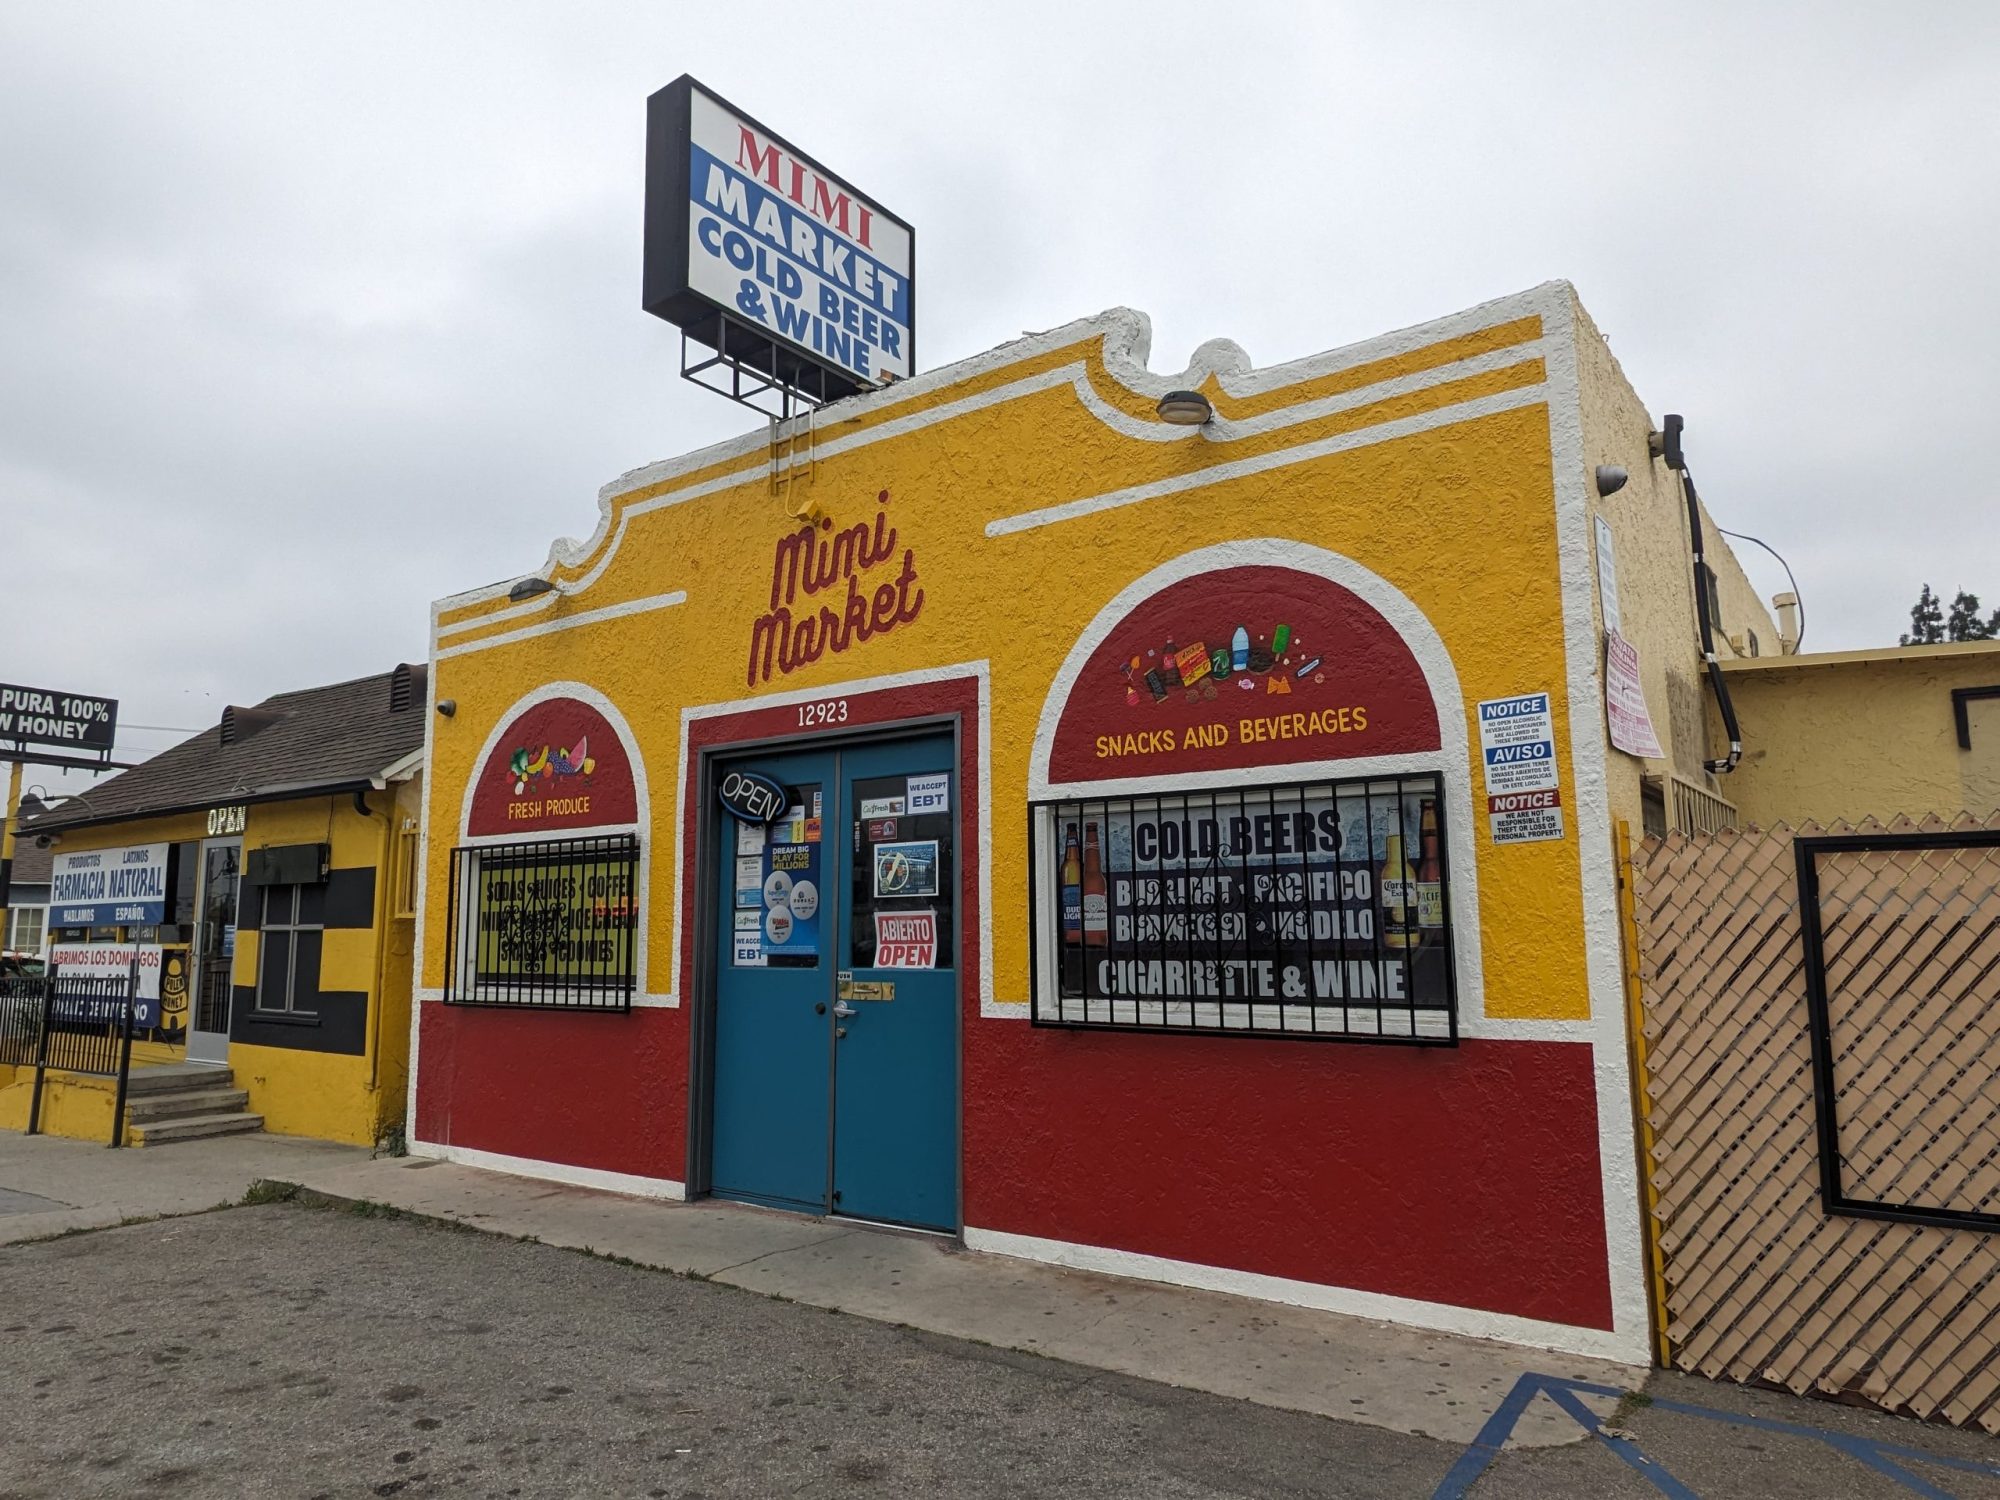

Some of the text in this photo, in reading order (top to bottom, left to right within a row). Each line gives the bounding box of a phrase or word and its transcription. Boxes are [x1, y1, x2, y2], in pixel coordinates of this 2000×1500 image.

[735, 123, 873, 251] MIMI
[705, 163, 898, 312] MARKET
[698, 216, 901, 360] COLD BEER
[770, 490, 897, 611] Mimi
[748, 549, 924, 687] Market
[1, 689, 109, 722] PURA 100%
[798, 700, 848, 726] 12923
[1486, 700, 1541, 718] NOTICE
[18, 715, 89, 740] HONEY
[1513, 716, 1542, 724] ALCOHOLIC
[1514, 721, 1546, 730] CONTAINERS
[1096, 706, 1368, 758] SNACKS AND BEVERAGES
[1506, 729, 1530, 737] ALLOWED
[1512, 734, 1539, 742] PREMISES
[1493, 744, 1545, 763] AVISO
[1508, 762, 1530, 770] PERMITE
[1516, 767, 1542, 775] ABIERTOS
[921, 782, 946, 790] ACCEPT
[1515, 773, 1552, 782] ALCOHOLICAS
[722, 772, 781, 821] OPEN
[912, 794, 944, 807] EBT
[1494, 792, 1554, 811] NOTICE
[508, 796, 590, 820] FRESH PRODUCE
[208, 806, 246, 835] OPEN
[1497, 817, 1540, 827] RESPONSIBLE
[1136, 809, 1342, 861] COLD BEERS
[1493, 829, 1562, 841] PERSONAL PROPERTY
[68, 849, 149, 869] PRODUCTOS LATINOS
[772, 846, 796, 855] DREAM
[772, 854, 791, 862] PLAY
[772, 861, 810, 870] MILLIONS
[54, 866, 162, 901] FARMACIA NATURAL
[487, 880, 524, 902] SODAS
[588, 874, 632, 898] COFFE
[1116, 879, 1160, 906] BUD
[115, 904, 145, 921] ESPAÑOL
[882, 918, 930, 941] ABIERTO
[90, 951, 107, 966] LOS
[738, 949, 762, 960] EBT
[878, 945, 932, 966] OPEN
[1282, 965, 1306, 997] &
[1312, 960, 1405, 999] WINE
